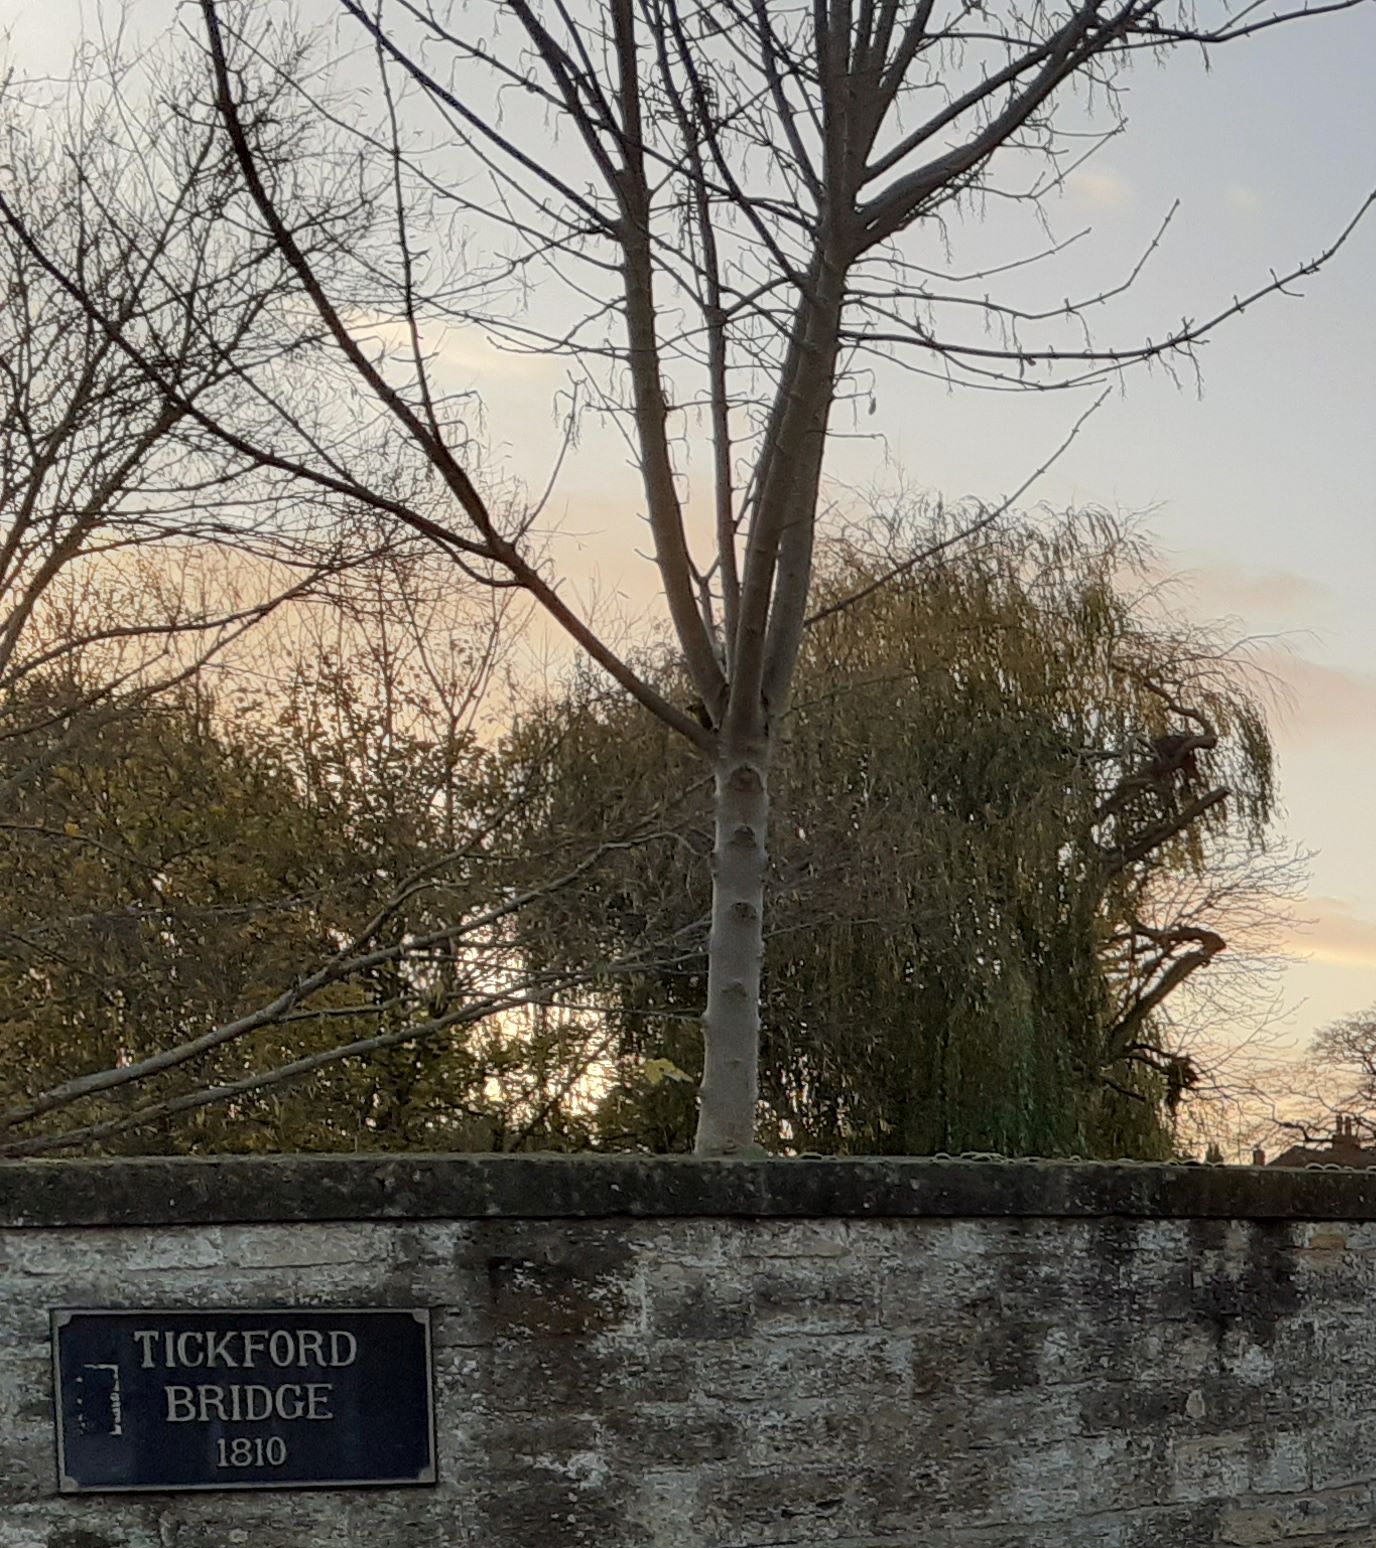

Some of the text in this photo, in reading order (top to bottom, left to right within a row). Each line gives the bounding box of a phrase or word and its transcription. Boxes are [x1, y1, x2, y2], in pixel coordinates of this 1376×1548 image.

[133, 1329, 358, 1369] TICKFORD
[164, 1383, 334, 1422] BRIDGE
[216, 1436, 288, 1468] 1810
